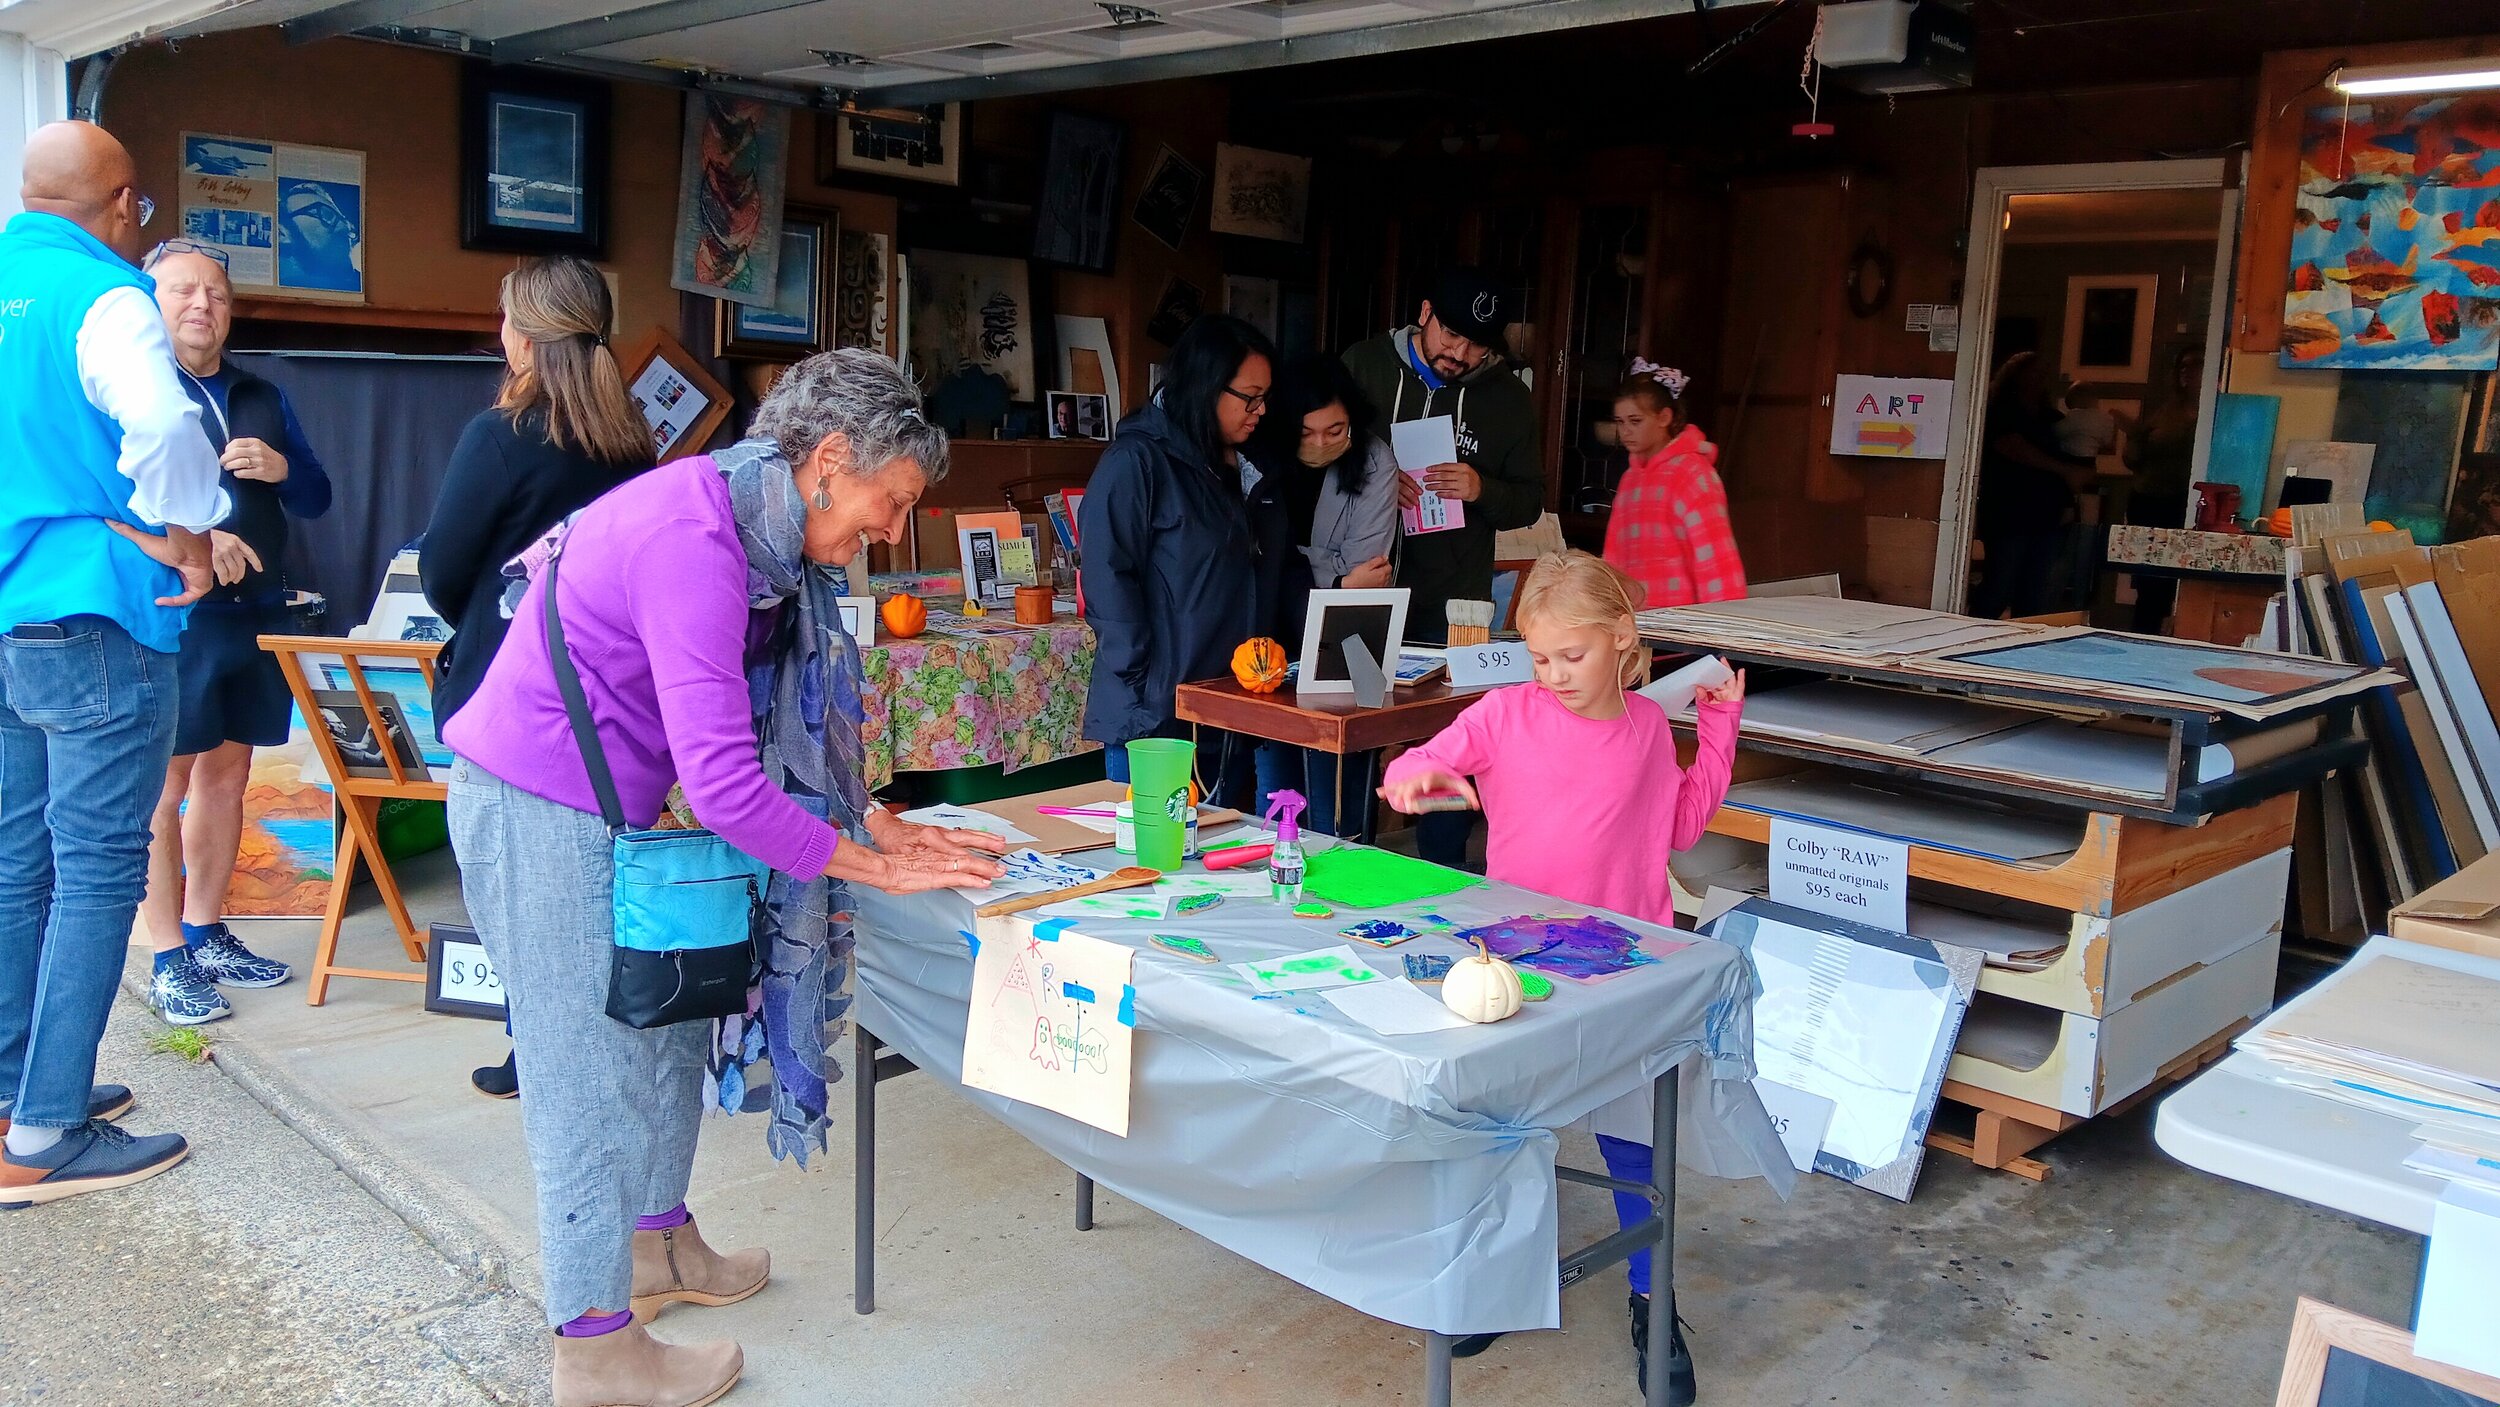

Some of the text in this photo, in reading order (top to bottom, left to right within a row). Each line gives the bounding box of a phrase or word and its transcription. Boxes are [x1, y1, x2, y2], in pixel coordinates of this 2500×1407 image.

[1856, 393, 1924, 417] ART
[1456, 434, 1479, 453] OHA
[1478, 651, 1510, 669] $ 95
[378, 799, 424, 821] groce
[1787, 837, 1889, 868] Colby “RAW”
[1785, 861, 1889, 892] unmatted originals
[1805, 881, 1867, 907] $95 each
[451, 960, 500, 988] $ 95
[1560, 1268, 1580, 1285] ETIME
